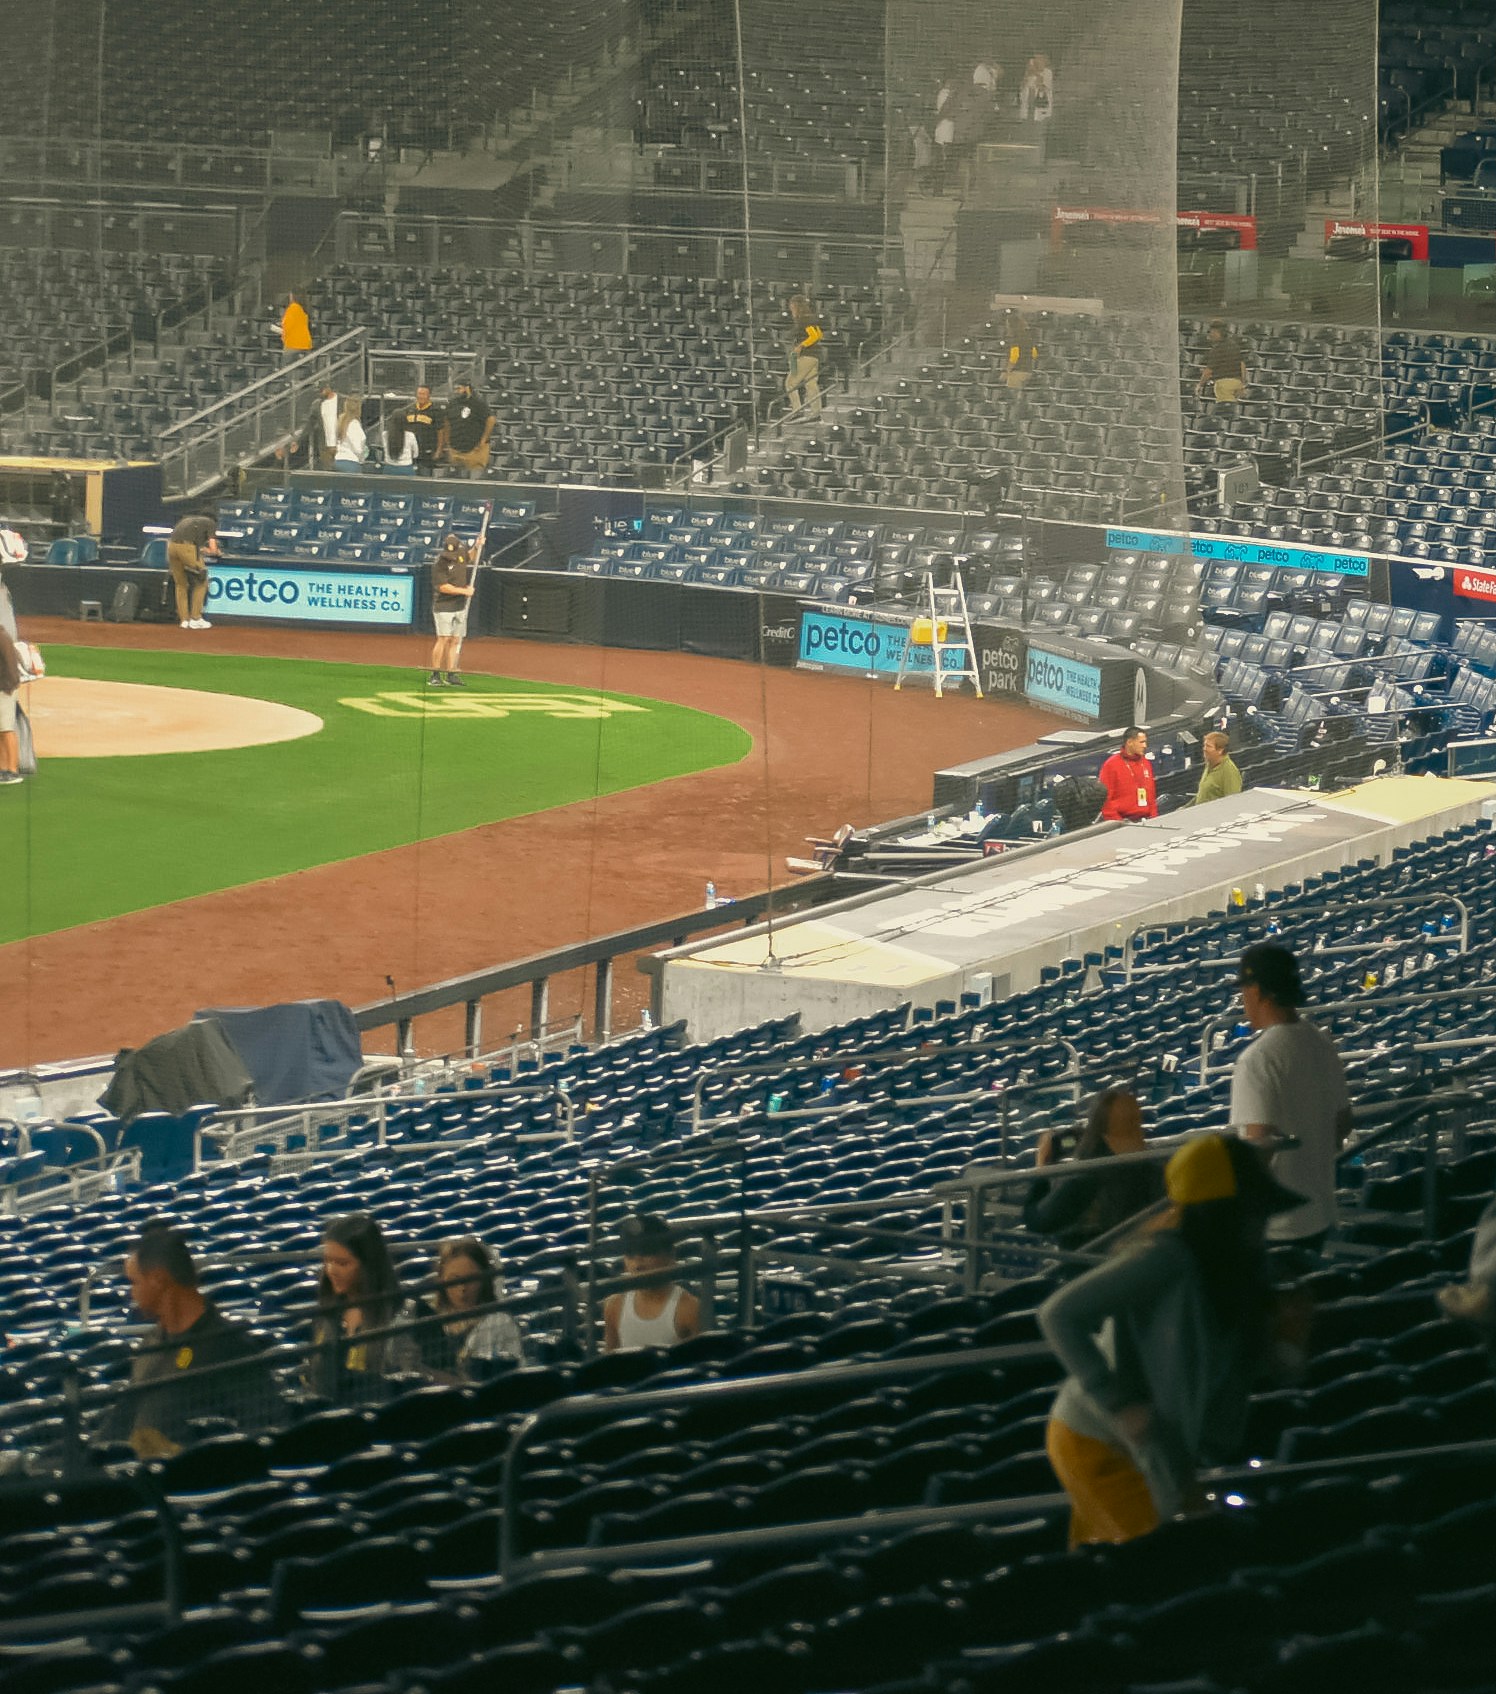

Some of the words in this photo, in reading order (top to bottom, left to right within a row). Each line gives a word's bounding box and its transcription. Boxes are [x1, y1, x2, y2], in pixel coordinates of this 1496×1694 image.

[1107, 532, 1139, 546] petco
[1191, 539, 1213, 554] etco
[1257, 549, 1290, 563] petco
[1334, 556, 1367, 572] petco
[308, 582, 332, 594] THE
[337, 584, 389, 598] HEALTH
[307, 596, 376, 610] WELLNESS
[380, 600, 405, 612] CO.
[806, 622, 881, 657] petco
[982, 648, 1018, 671] petco
[988, 669, 1017, 691] park
[1026, 656, 1064, 692] petco
